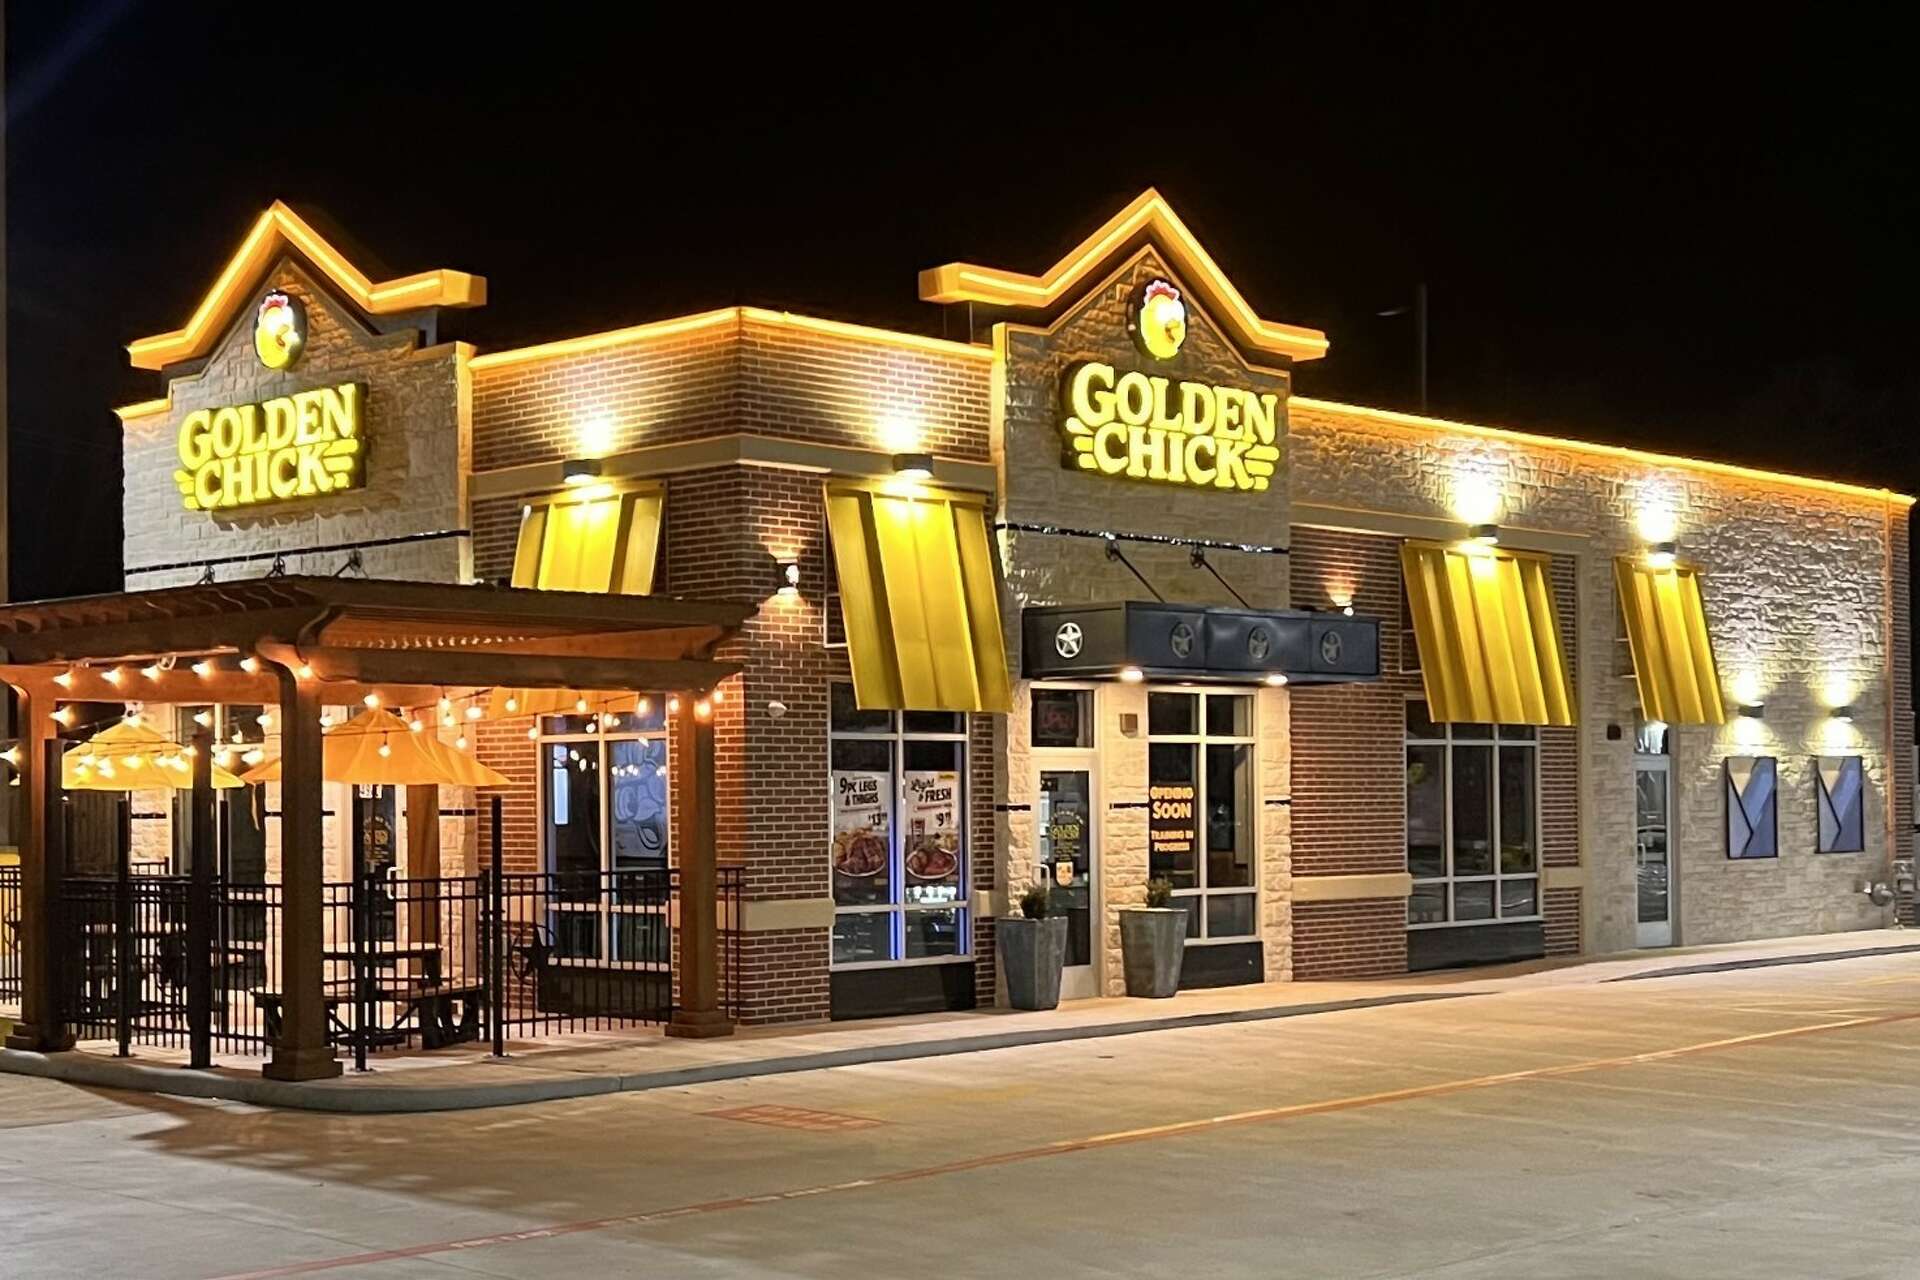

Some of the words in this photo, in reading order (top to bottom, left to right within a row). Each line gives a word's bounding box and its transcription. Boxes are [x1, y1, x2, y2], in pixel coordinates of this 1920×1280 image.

[178, 383, 357, 470] GOLDEN
[1073, 362, 1278, 444] GOLDEN
[194, 442, 334, 509] CHICK
[1094, 422, 1255, 490] CHICK
[859, 779, 877, 792] LEGS
[925, 787, 952, 803] FRESH
[1152, 801, 1192, 819] SOON
